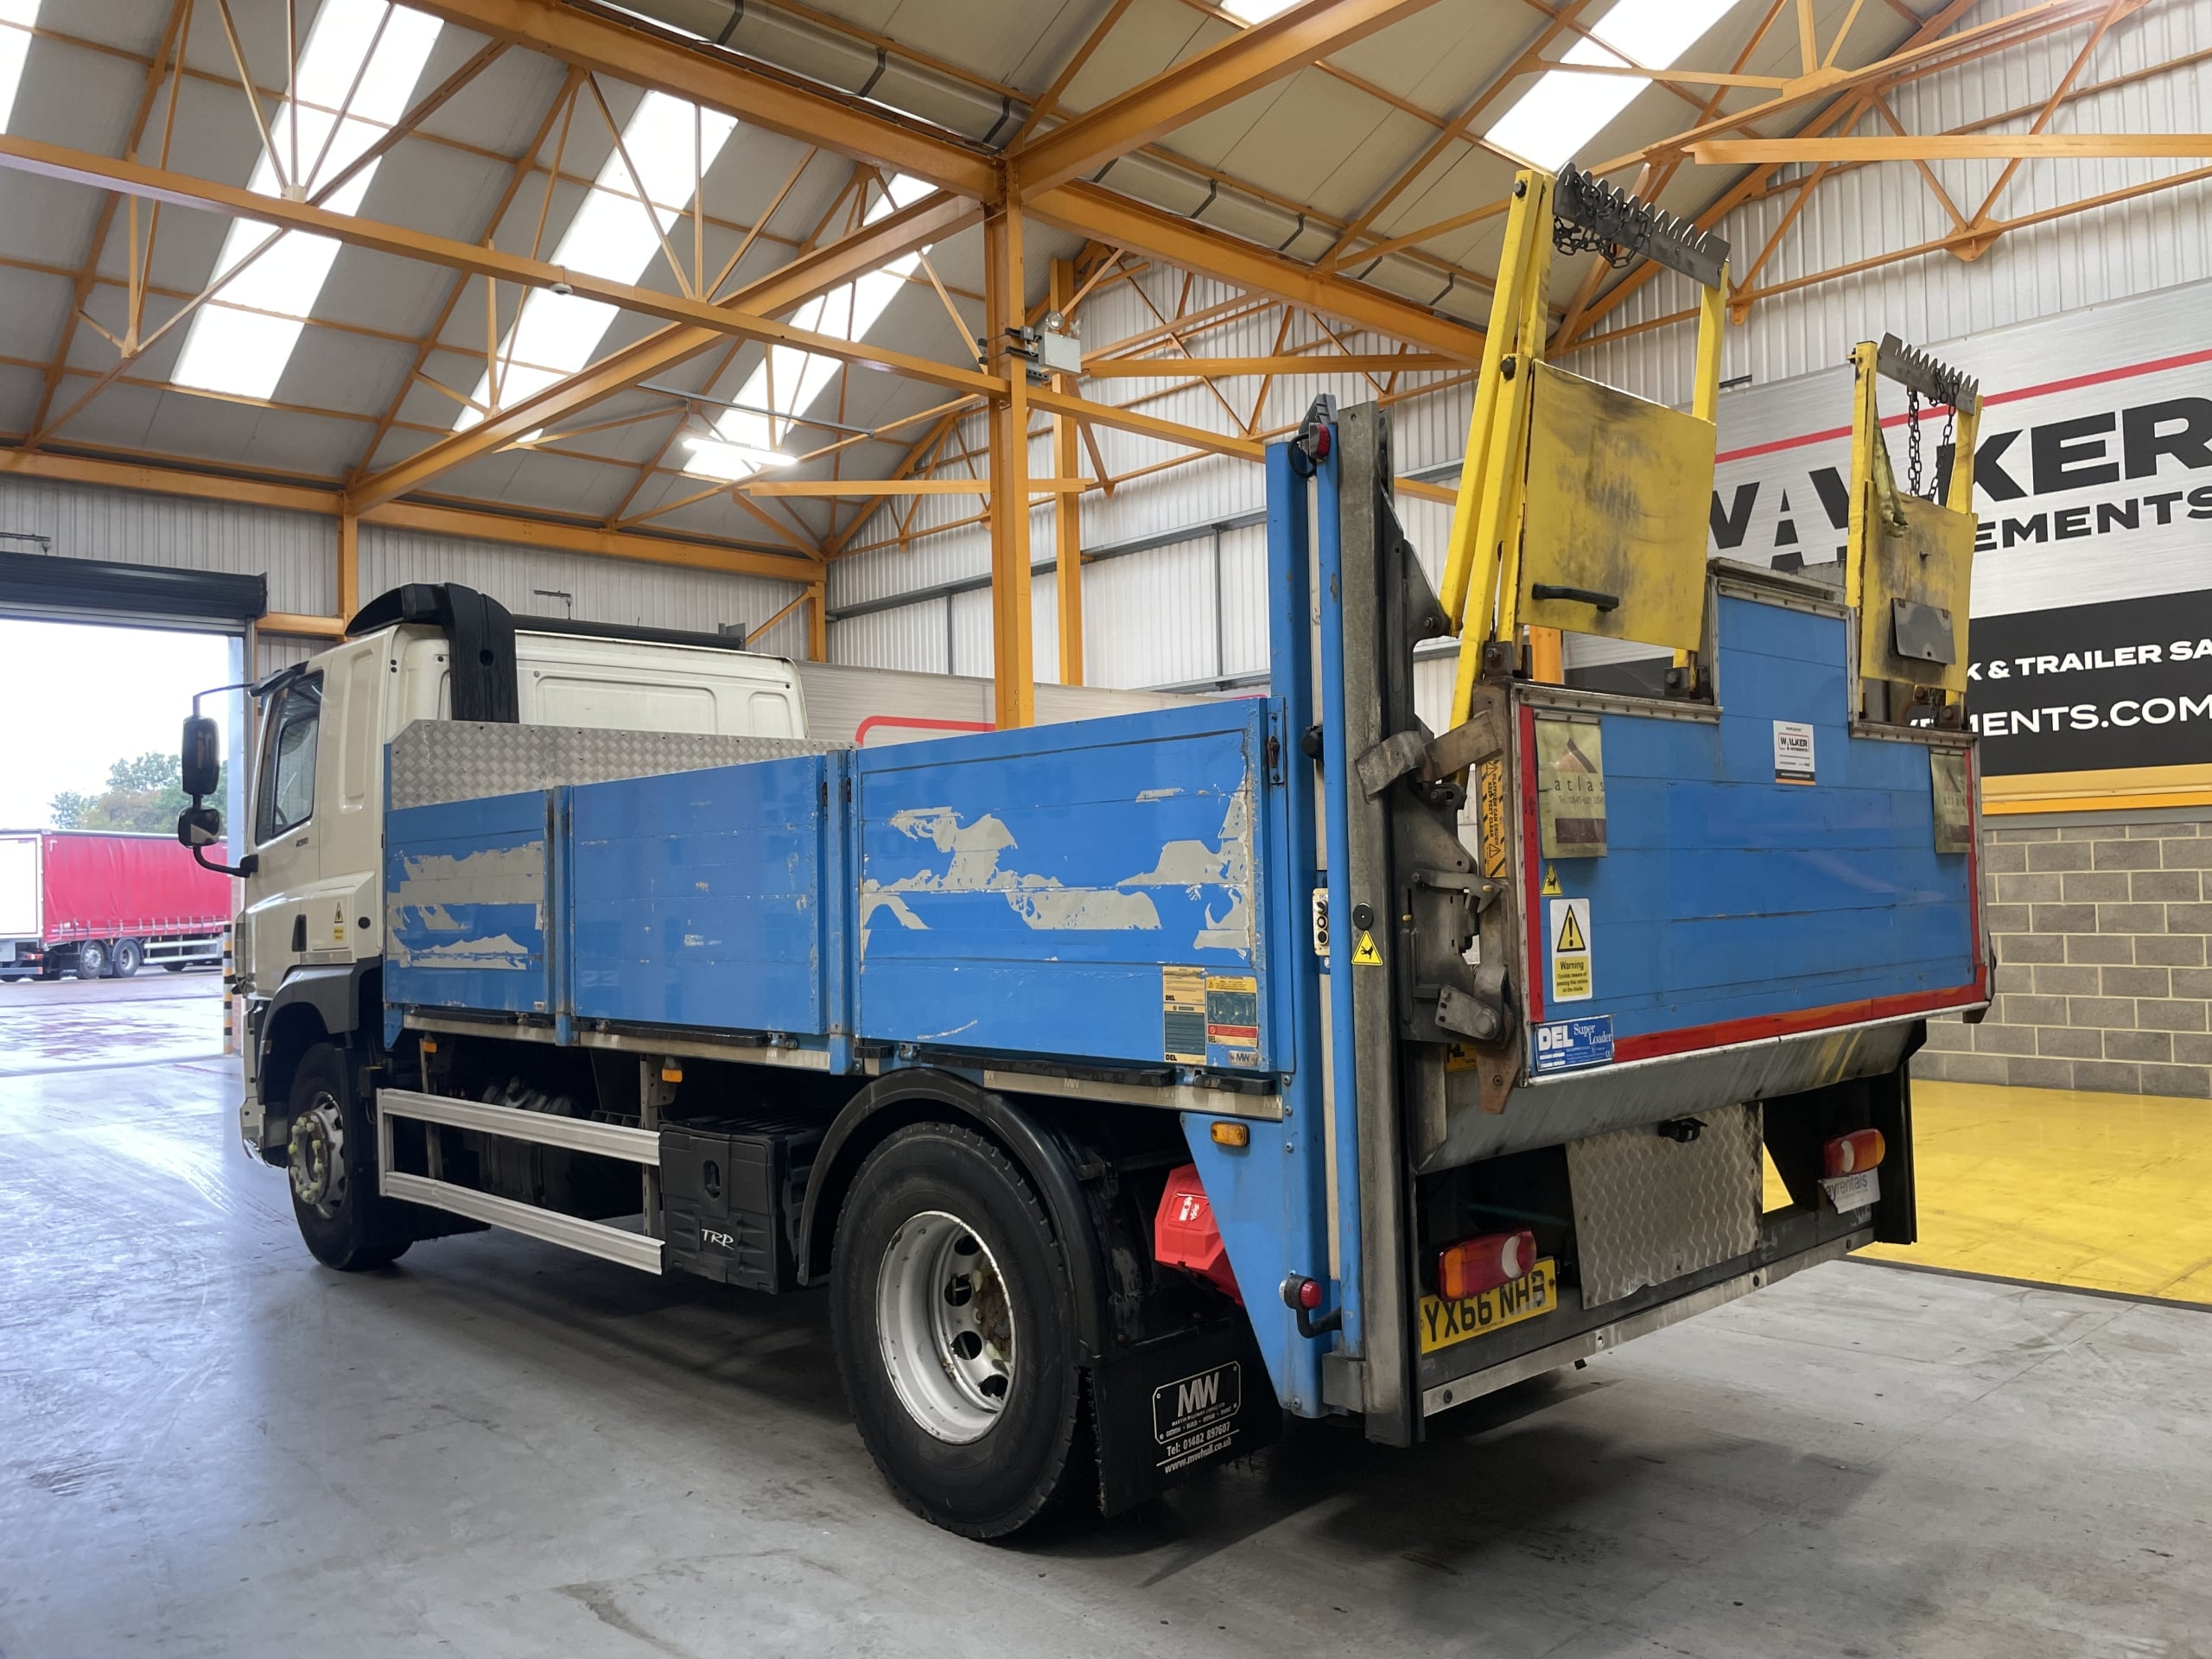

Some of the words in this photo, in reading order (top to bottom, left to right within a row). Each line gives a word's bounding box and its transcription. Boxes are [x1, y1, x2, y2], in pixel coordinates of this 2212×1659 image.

[1988, 660, 2011, 679] &
[2015, 644, 2163, 677] TRAILER
[1560, 961, 1585, 970] Warning
[1539, 1025, 1574, 1052] DEL
[1573, 1022, 1596, 1038] Super
[1589, 1030, 1612, 1046] Loader
[1236, 1053, 1250, 1062] MW
[701, 1228, 734, 1250] TRP
[1424, 1291, 1493, 1343] YX66
[1178, 1371, 1220, 1417] MW
[1164, 1436, 1232, 1474] www.mwhull.co.uk
[1166, 1442, 1181, 1457] Tel:
[1183, 1432, 1205, 1450] 01482
